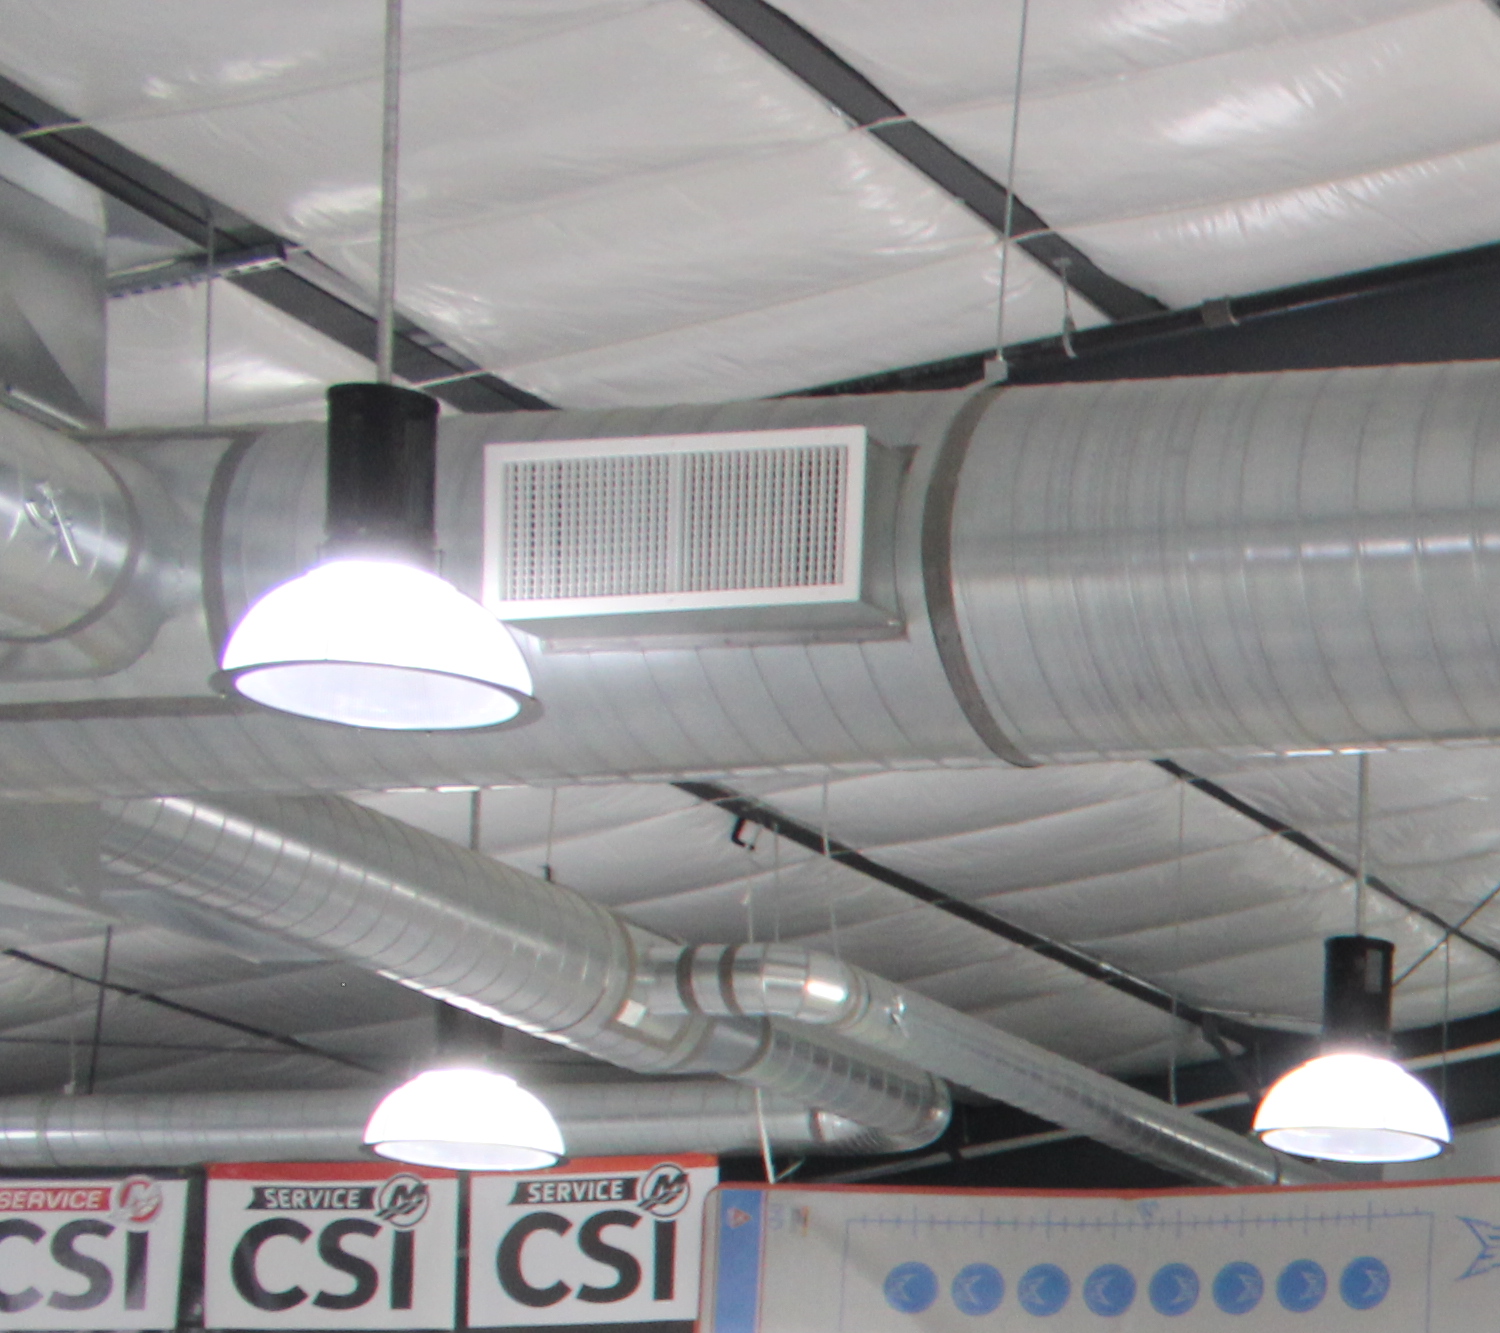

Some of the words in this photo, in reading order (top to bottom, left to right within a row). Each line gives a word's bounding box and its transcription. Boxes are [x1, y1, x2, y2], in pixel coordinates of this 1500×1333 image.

[263, 1188, 360, 1209] SERVICE
[527, 1180, 624, 1203] SERVICE
[230, 1216, 415, 1313] CSI
[496, 1208, 677, 1308] CSI
